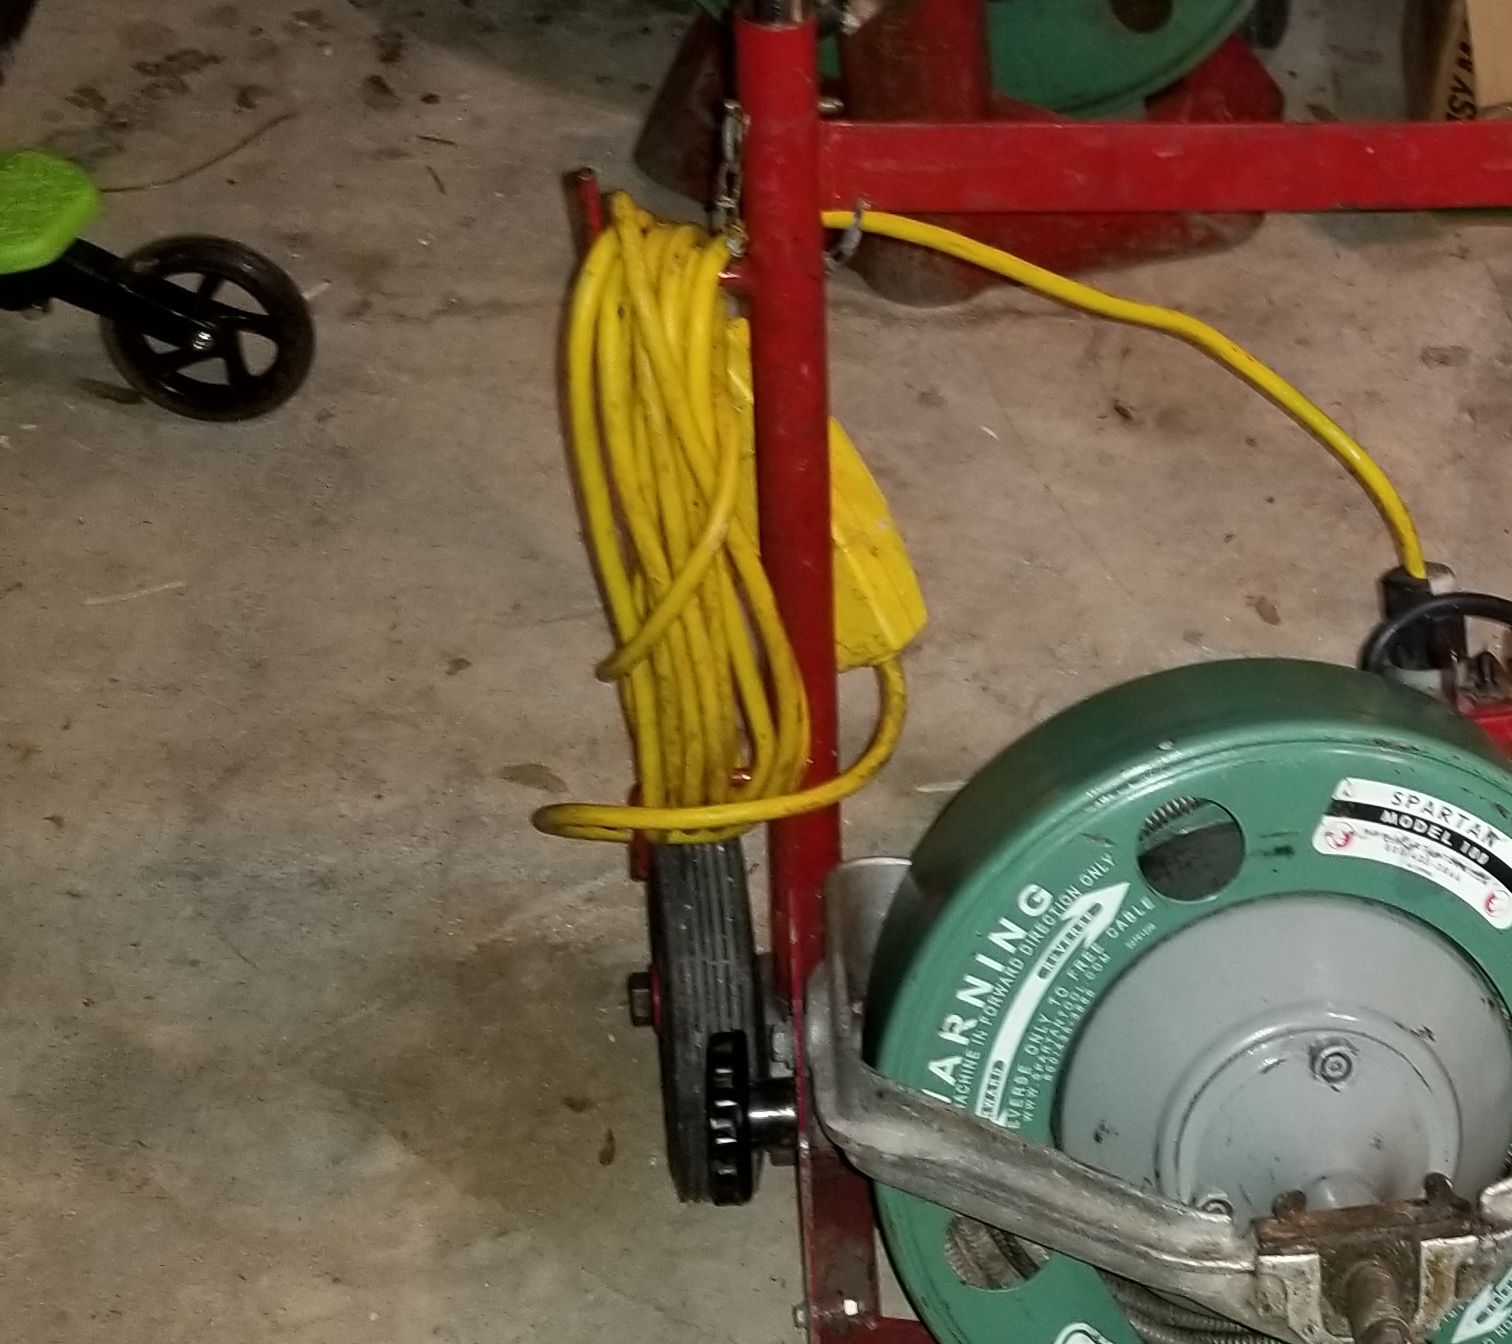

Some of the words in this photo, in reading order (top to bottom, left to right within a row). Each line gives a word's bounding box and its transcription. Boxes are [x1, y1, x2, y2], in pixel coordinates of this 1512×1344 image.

[1379, 810, 1453, 847] MODEL
[1391, 791, 1500, 847] SPARTAN
[1079, 850, 1117, 888] ONLY
[1017, 885, 1082, 957] DIRECTION
[921, 883, 1054, 1104] ARNING
[979, 956, 1026, 1027] FORWARD
[1024, 1013, 1053, 1056] ONLY
[1049, 986, 1069, 1007] TO
[1066, 941, 1106, 982] FREE
[1107, 896, 1156, 939] CABLE
[972, 1029, 989, 1046] IN
[953, 1051, 982, 1109] ACHINE
